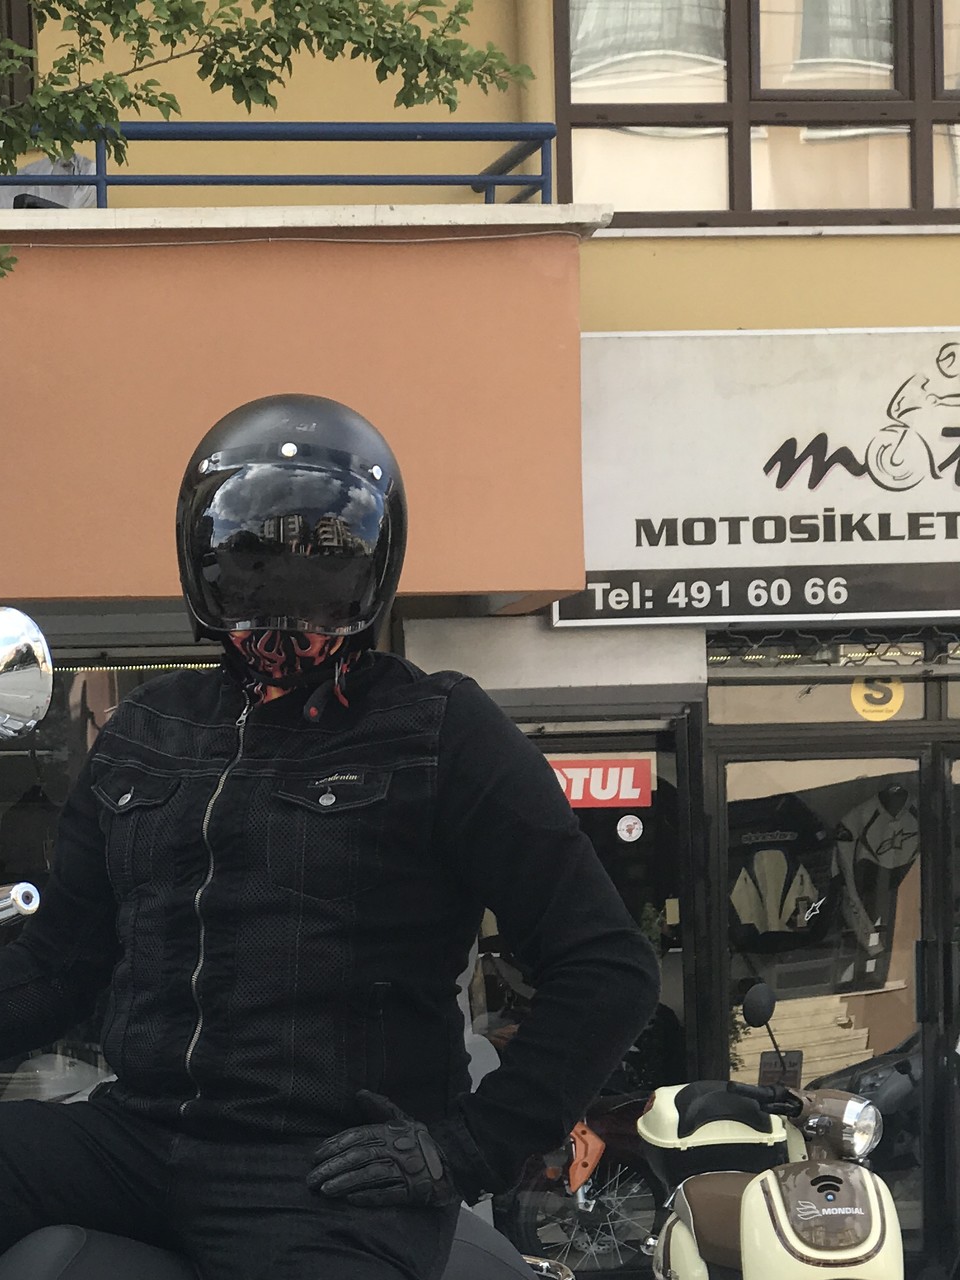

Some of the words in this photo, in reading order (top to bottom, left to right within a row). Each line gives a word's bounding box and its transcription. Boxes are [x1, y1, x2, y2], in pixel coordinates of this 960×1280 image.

[587, 581, 653, 611] Tel:
[667, 580, 731, 609] 491
[747, 579, 791, 607] 60
[804, 577, 848, 606] 66
[822, 1207, 865, 1216] MONDIAL
